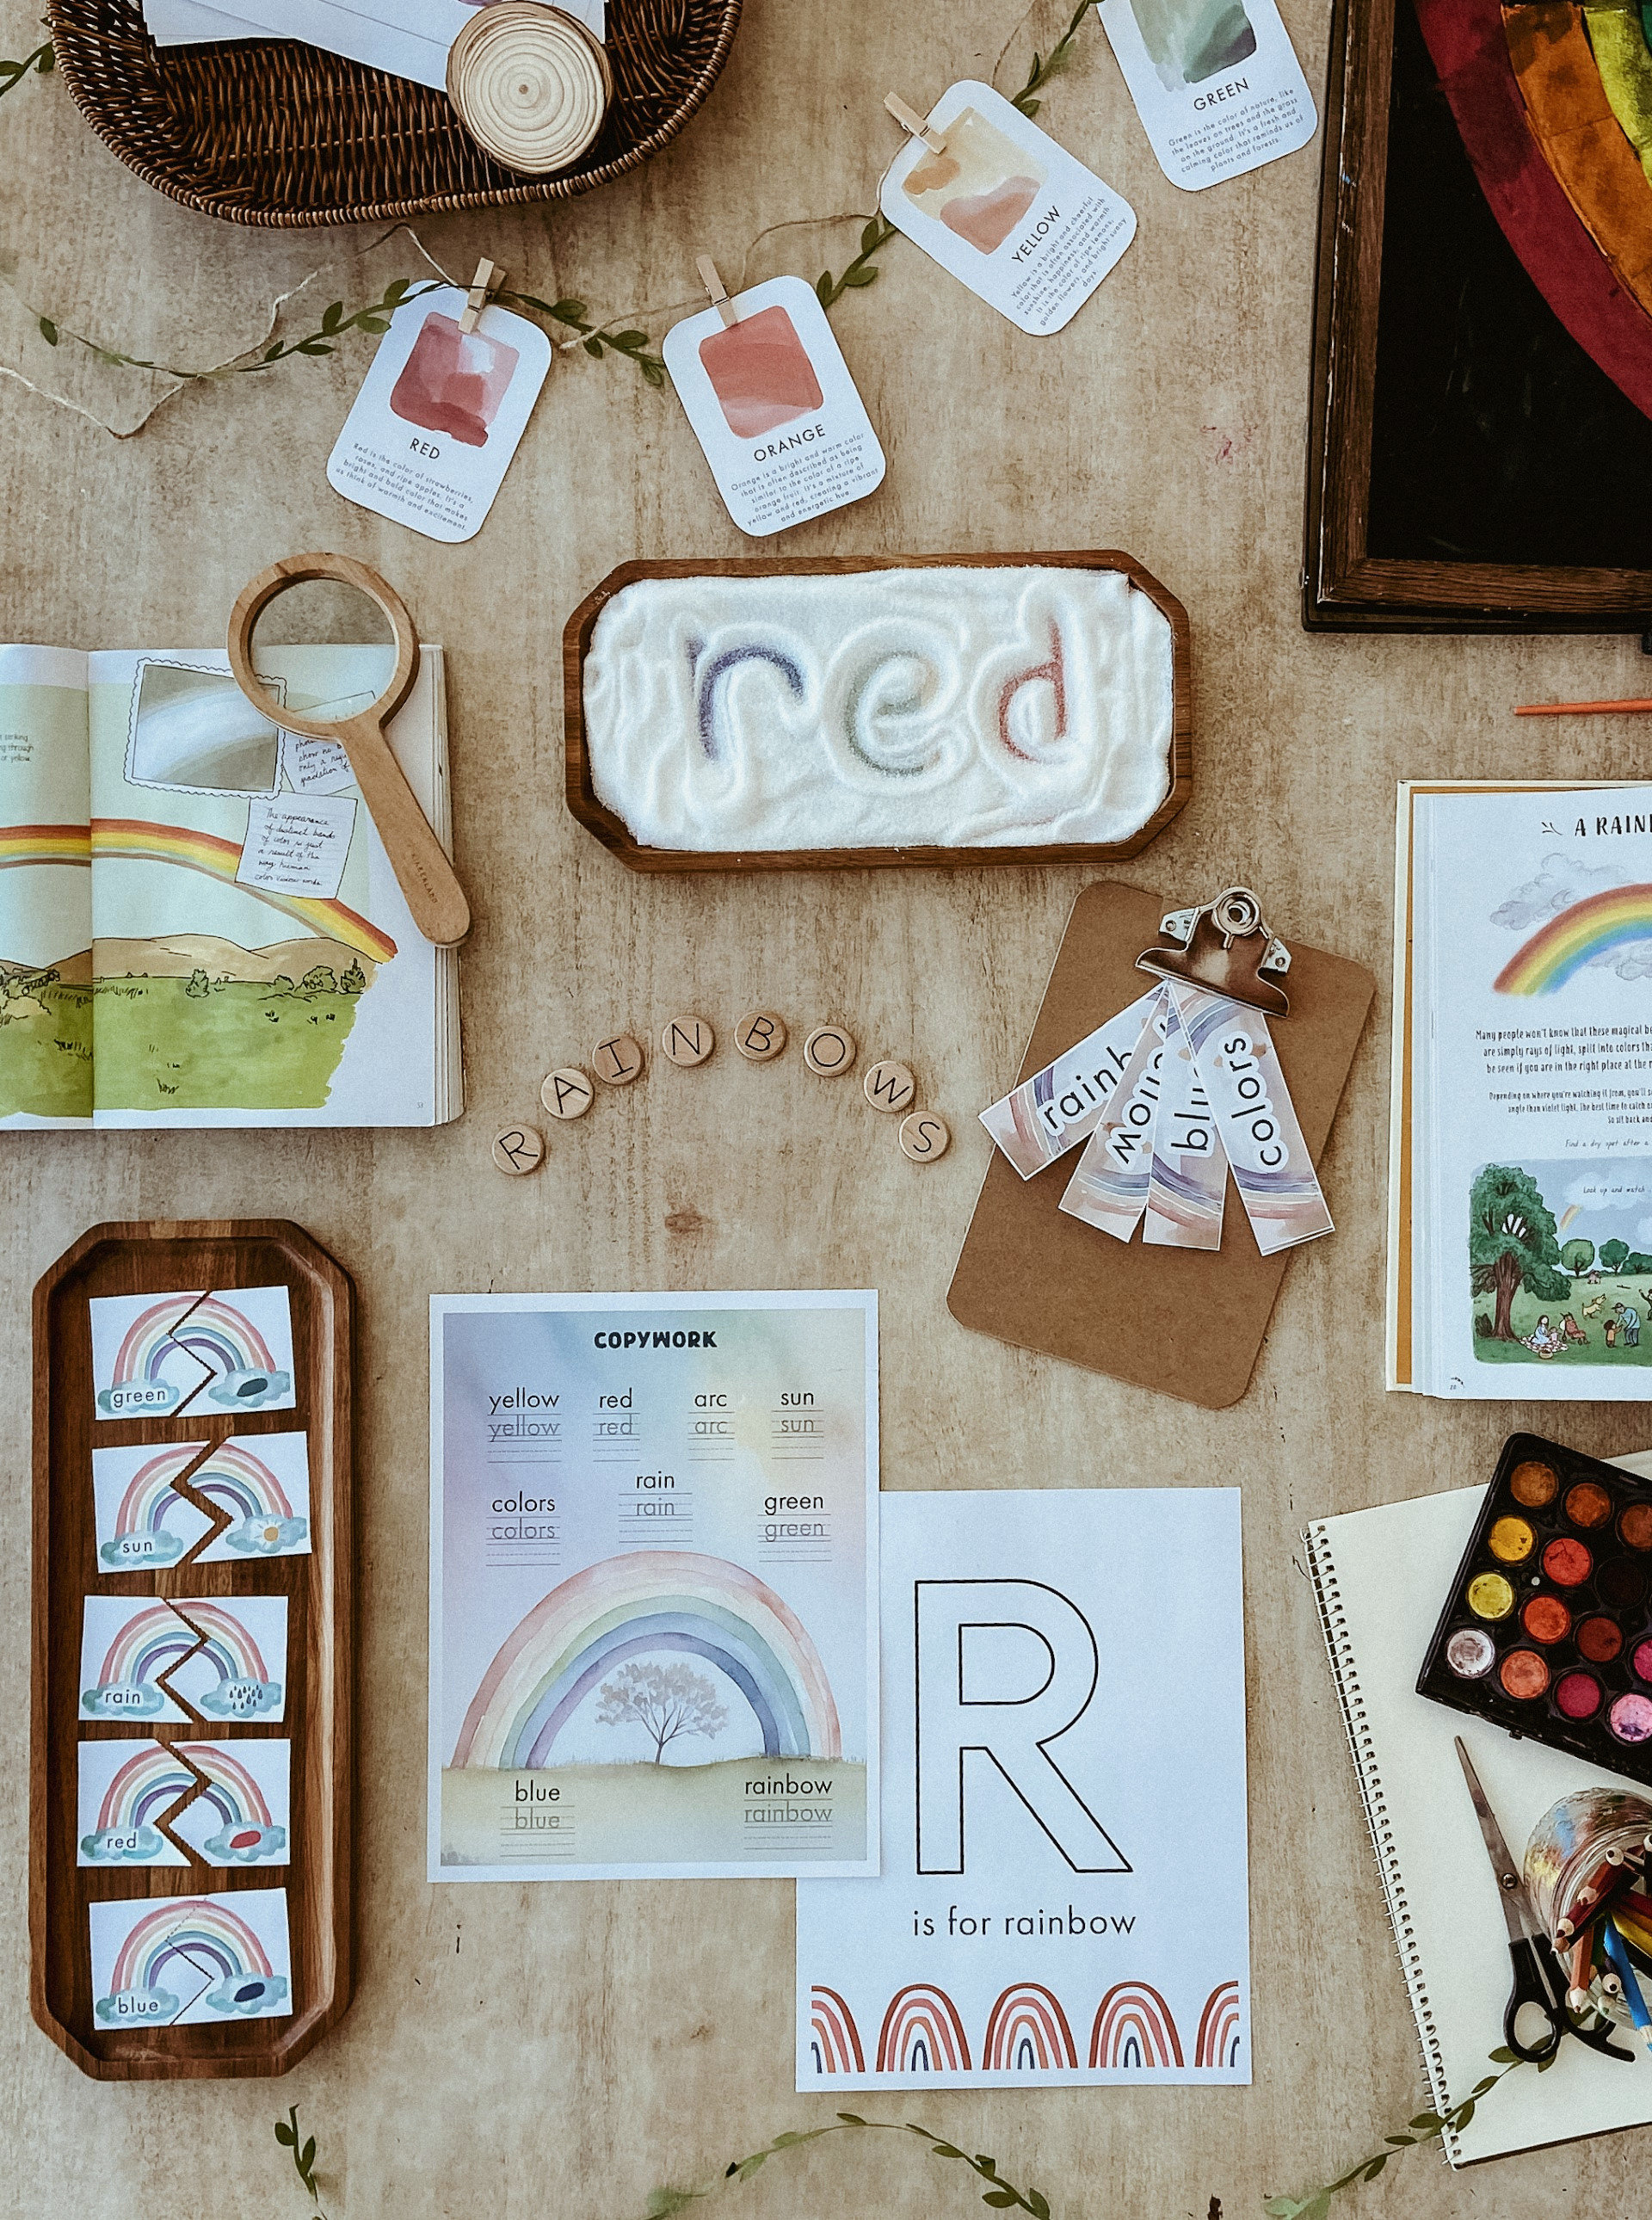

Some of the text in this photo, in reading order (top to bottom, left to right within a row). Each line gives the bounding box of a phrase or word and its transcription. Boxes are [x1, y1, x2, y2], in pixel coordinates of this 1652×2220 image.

[1193, 77, 1249, 111] GREEN
[1168, 132, 1193, 146] Green
[1202, 122, 1215, 132] the
[1217, 112, 1237, 126] color
[1239, 105, 1248, 115] of
[1249, 96, 1278, 111] nature,
[1278, 88, 1293, 98] like
[1171, 146, 1184, 156] the
[1184, 134, 1211, 150] leaves
[1224, 120, 1244, 133] trees
[1245, 110, 1261, 123] and
[1261, 106, 1275, 116] the
[1276, 97, 1298, 111] grass
[1010, 205, 1061, 263] YELLOW
[1010, 274, 1031, 298] Yellow
[1039, 239, 1060, 262] bright
[1057, 224, 1071, 240] and
[1069, 196, 1094, 225] cheerful
[1014, 290, 1032, 310] color
[1029, 275, 1043, 291] that
[1047, 250, 1064, 268] often
[1062, 212, 1093, 250] associated
[1091, 197, 1106, 213] with
[410, 437, 440, 459] RED
[753, 423, 825, 462] ORANGE
[353, 442, 368, 453] Red
[378, 453, 391, 465] the
[391, 461, 414, 475] color
[424, 476, 473, 503] strawberries,
[730, 475, 761, 491] Orange
[778, 457, 803, 472] bright
[804, 449, 819, 461] and
[821, 442, 842, 454] warm
[843, 432, 864, 446] color
[740, 486, 756, 497] that
[767, 474, 787, 487] often
[788, 456, 827, 478] described
[839, 444, 862, 457] being
[342, 458, 468, 521] bright and bold color that makes
[686, 608, 1067, 776] red
[1575, 814, 1652, 836] A RAIN
[1475, 1030, 1495, 1041] Many
[1498, 1028, 1524, 1041] people
[1549, 1027, 1569, 1038] know
[1571, 1027, 1587, 1037] that
[1589, 1027, 1609, 1037] these
[1612, 1025, 1643, 1038] magical
[1483, 1047, 1495, 1057] are
[1497, 1045, 1524, 1058] simply
[1526, 1046, 1542, 1058] rays
[1544, 1044, 1552, 1057] of
[1555, 1045, 1576, 1057] light,
[1578, 1043, 1596, 1056] split
[1598, 1043, 1613, 1053] into
[1616, 1042, 1640, 1053] colors
[1487, 1059, 1646, 1075] be seen if you are in the right place at the
[1225, 1037, 1283, 1167] colors
[1573, 1090, 1600, 1099] watching
[1625, 1115, 1640, 1124] back
[1590, 1139, 1601, 1149] dry
[1600, 1187, 1607, 1196] up
[594, 1331, 718, 1348] COPYWORK
[114, 1390, 165, 1408] green
[489, 1387, 559, 1415] yellow
[600, 1387, 632, 1409] red
[694, 1394, 727, 1408] arc
[780, 1391, 814, 1406] sun
[489, 1414, 559, 1442] yellow
[600, 1413, 632, 1435] red
[694, 1421, 727, 1434] arc
[780, 1419, 814, 1433] sun
[636, 1471, 675, 1489] rain
[492, 1490, 556, 1512] colors
[636, 1497, 675, 1516] rain
[764, 1495, 823, 1516] green
[492, 1517, 556, 1539] colors
[765, 1522, 823, 1543] green
[122, 1541, 152, 1553] sun
[105, 1689, 140, 1704] rain
[914, 1577, 1134, 1876] R
[515, 1779, 561, 1802] blue
[745, 1773, 833, 1795] rainbow
[515, 1807, 561, 1829] blue
[744, 1800, 833, 1822] rainbow
[107, 1832, 137, 1848] red
[914, 1904, 1136, 1936] is for rainbow
[118, 1996, 158, 2013] blue
